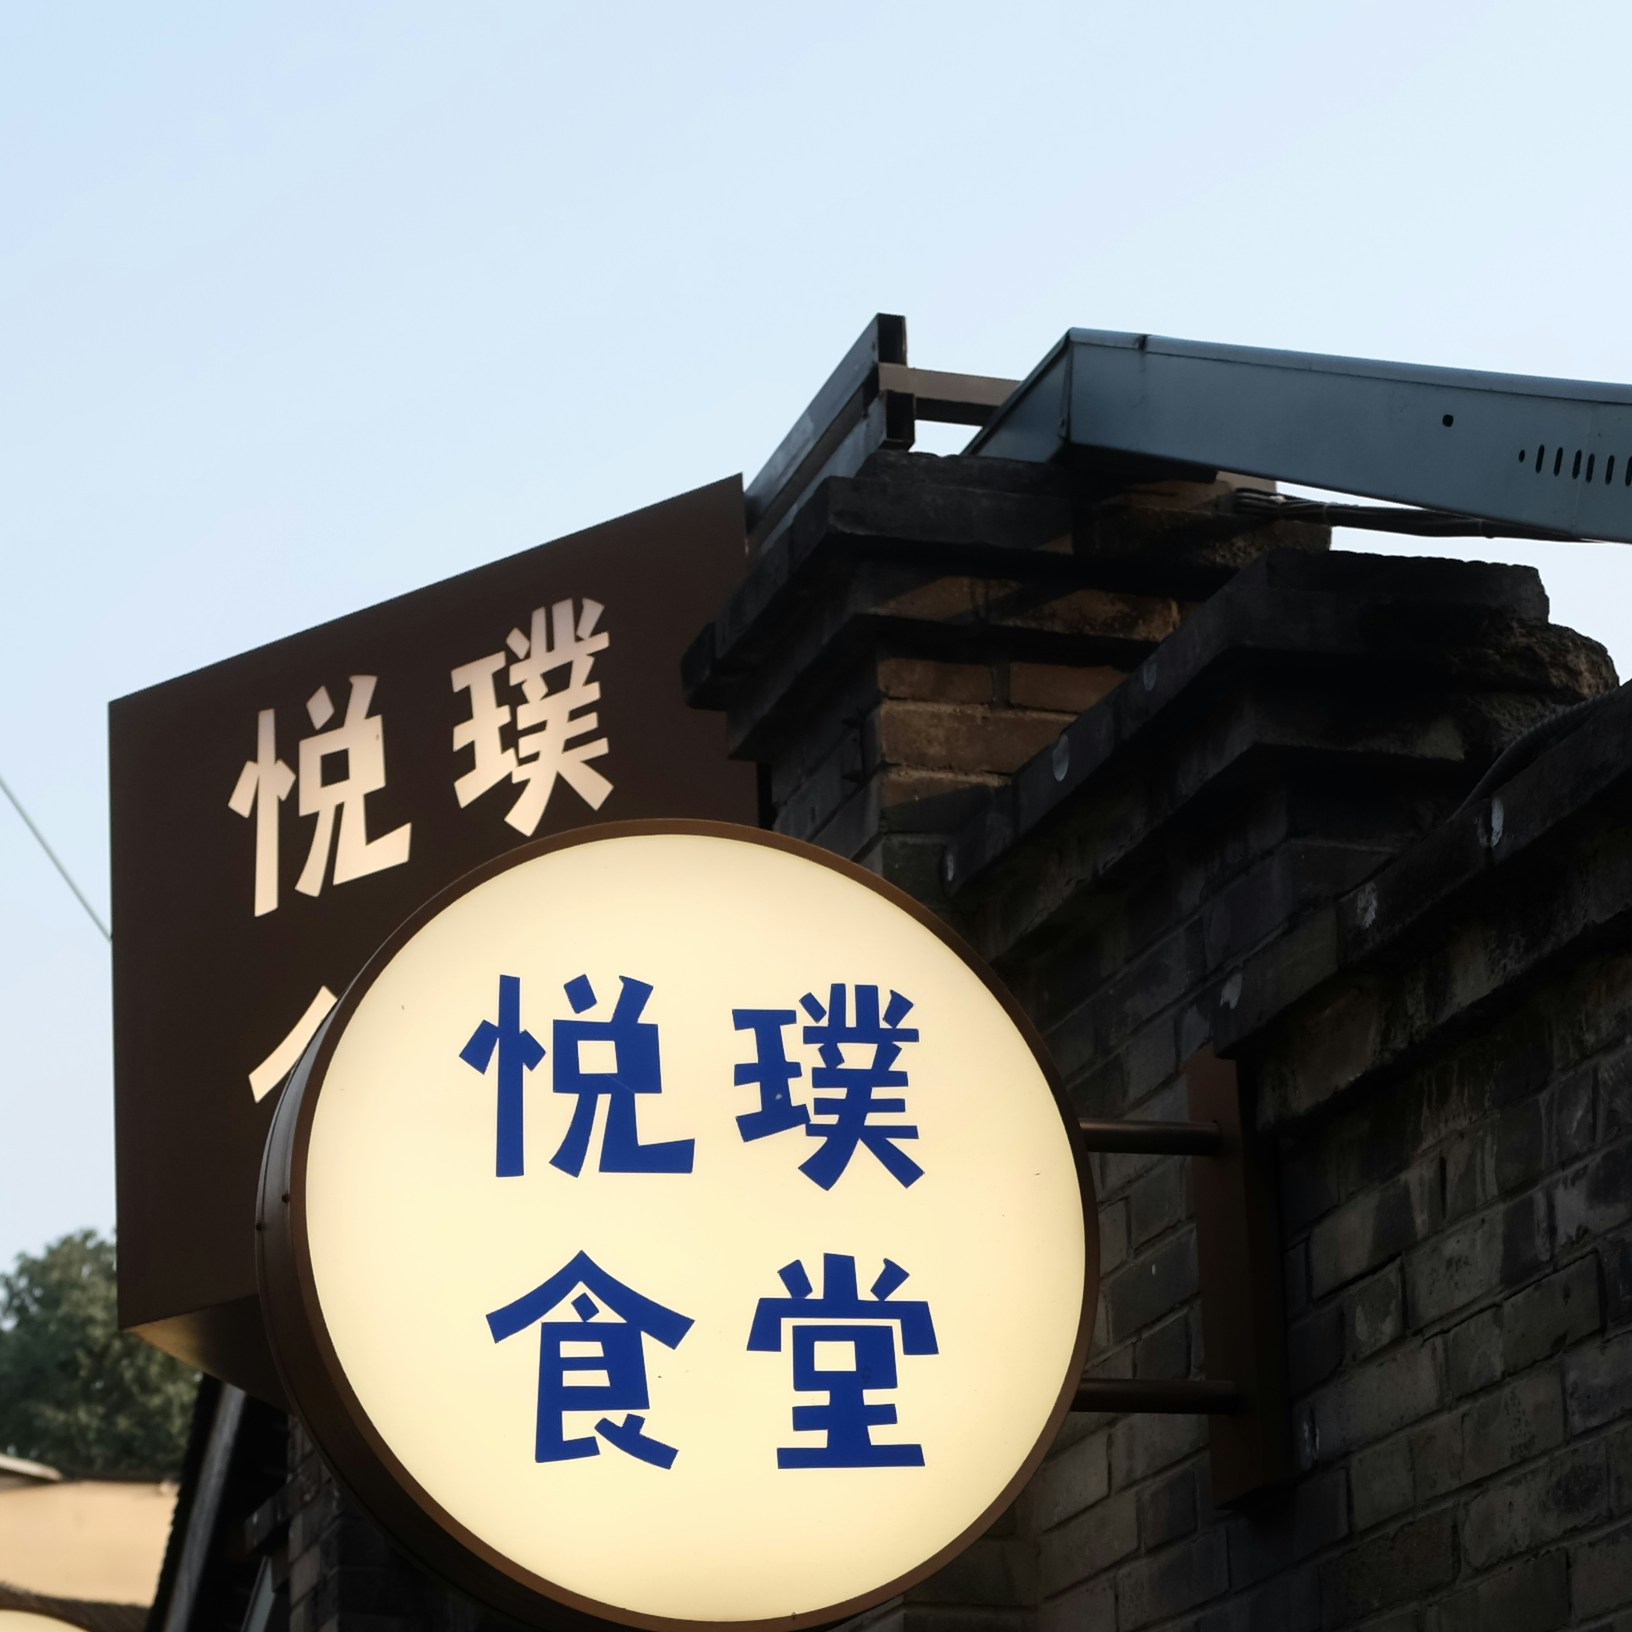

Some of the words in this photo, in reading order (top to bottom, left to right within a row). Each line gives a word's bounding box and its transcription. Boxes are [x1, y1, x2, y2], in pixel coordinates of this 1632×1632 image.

[227, 597, 614, 917] 悦璞
[459, 974, 926, 1190] 悦璞
[486, 1250, 940, 1470] 食堂
